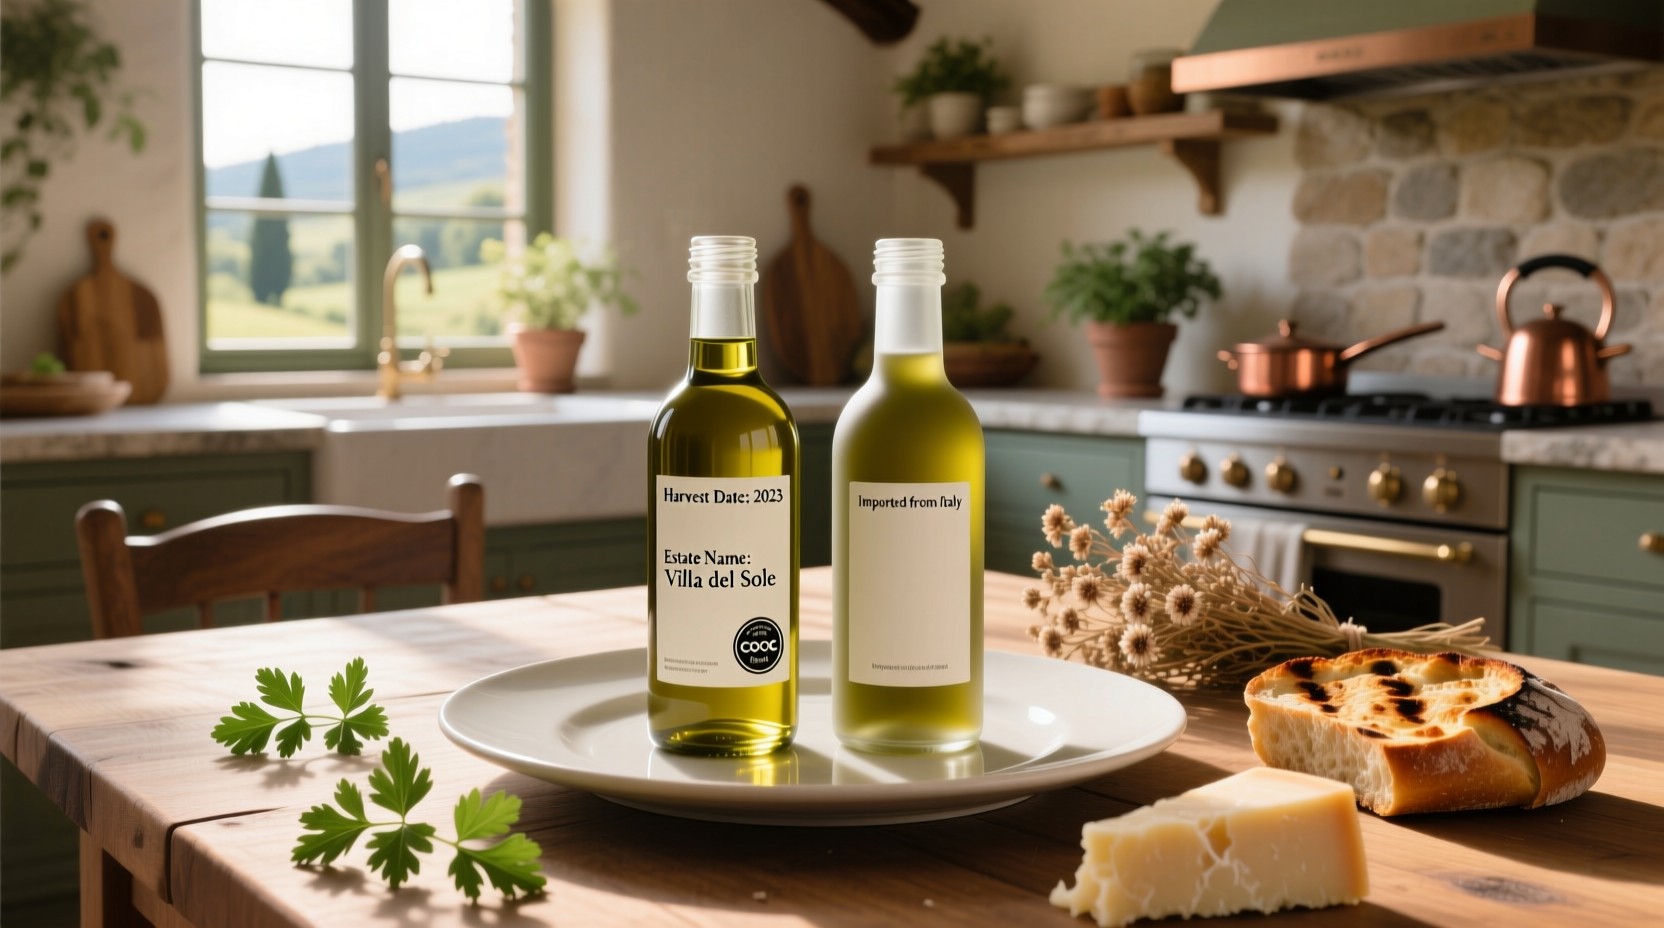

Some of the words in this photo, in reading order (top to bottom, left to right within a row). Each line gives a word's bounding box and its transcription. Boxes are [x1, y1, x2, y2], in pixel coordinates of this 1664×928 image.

[663, 487, 709, 503] Harvest
[753, 488, 783, 503] 2023
[858, 494, 907, 512] Imported
[909, 495, 938, 508] from
[664, 549, 702, 565] Estate
[704, 550, 751, 565] Name:
[664, 568, 703, 588] Villa
[708, 569, 734, 588] del
[740, 567, 776, 588] Sole
[740, 639, 778, 654] COOC
